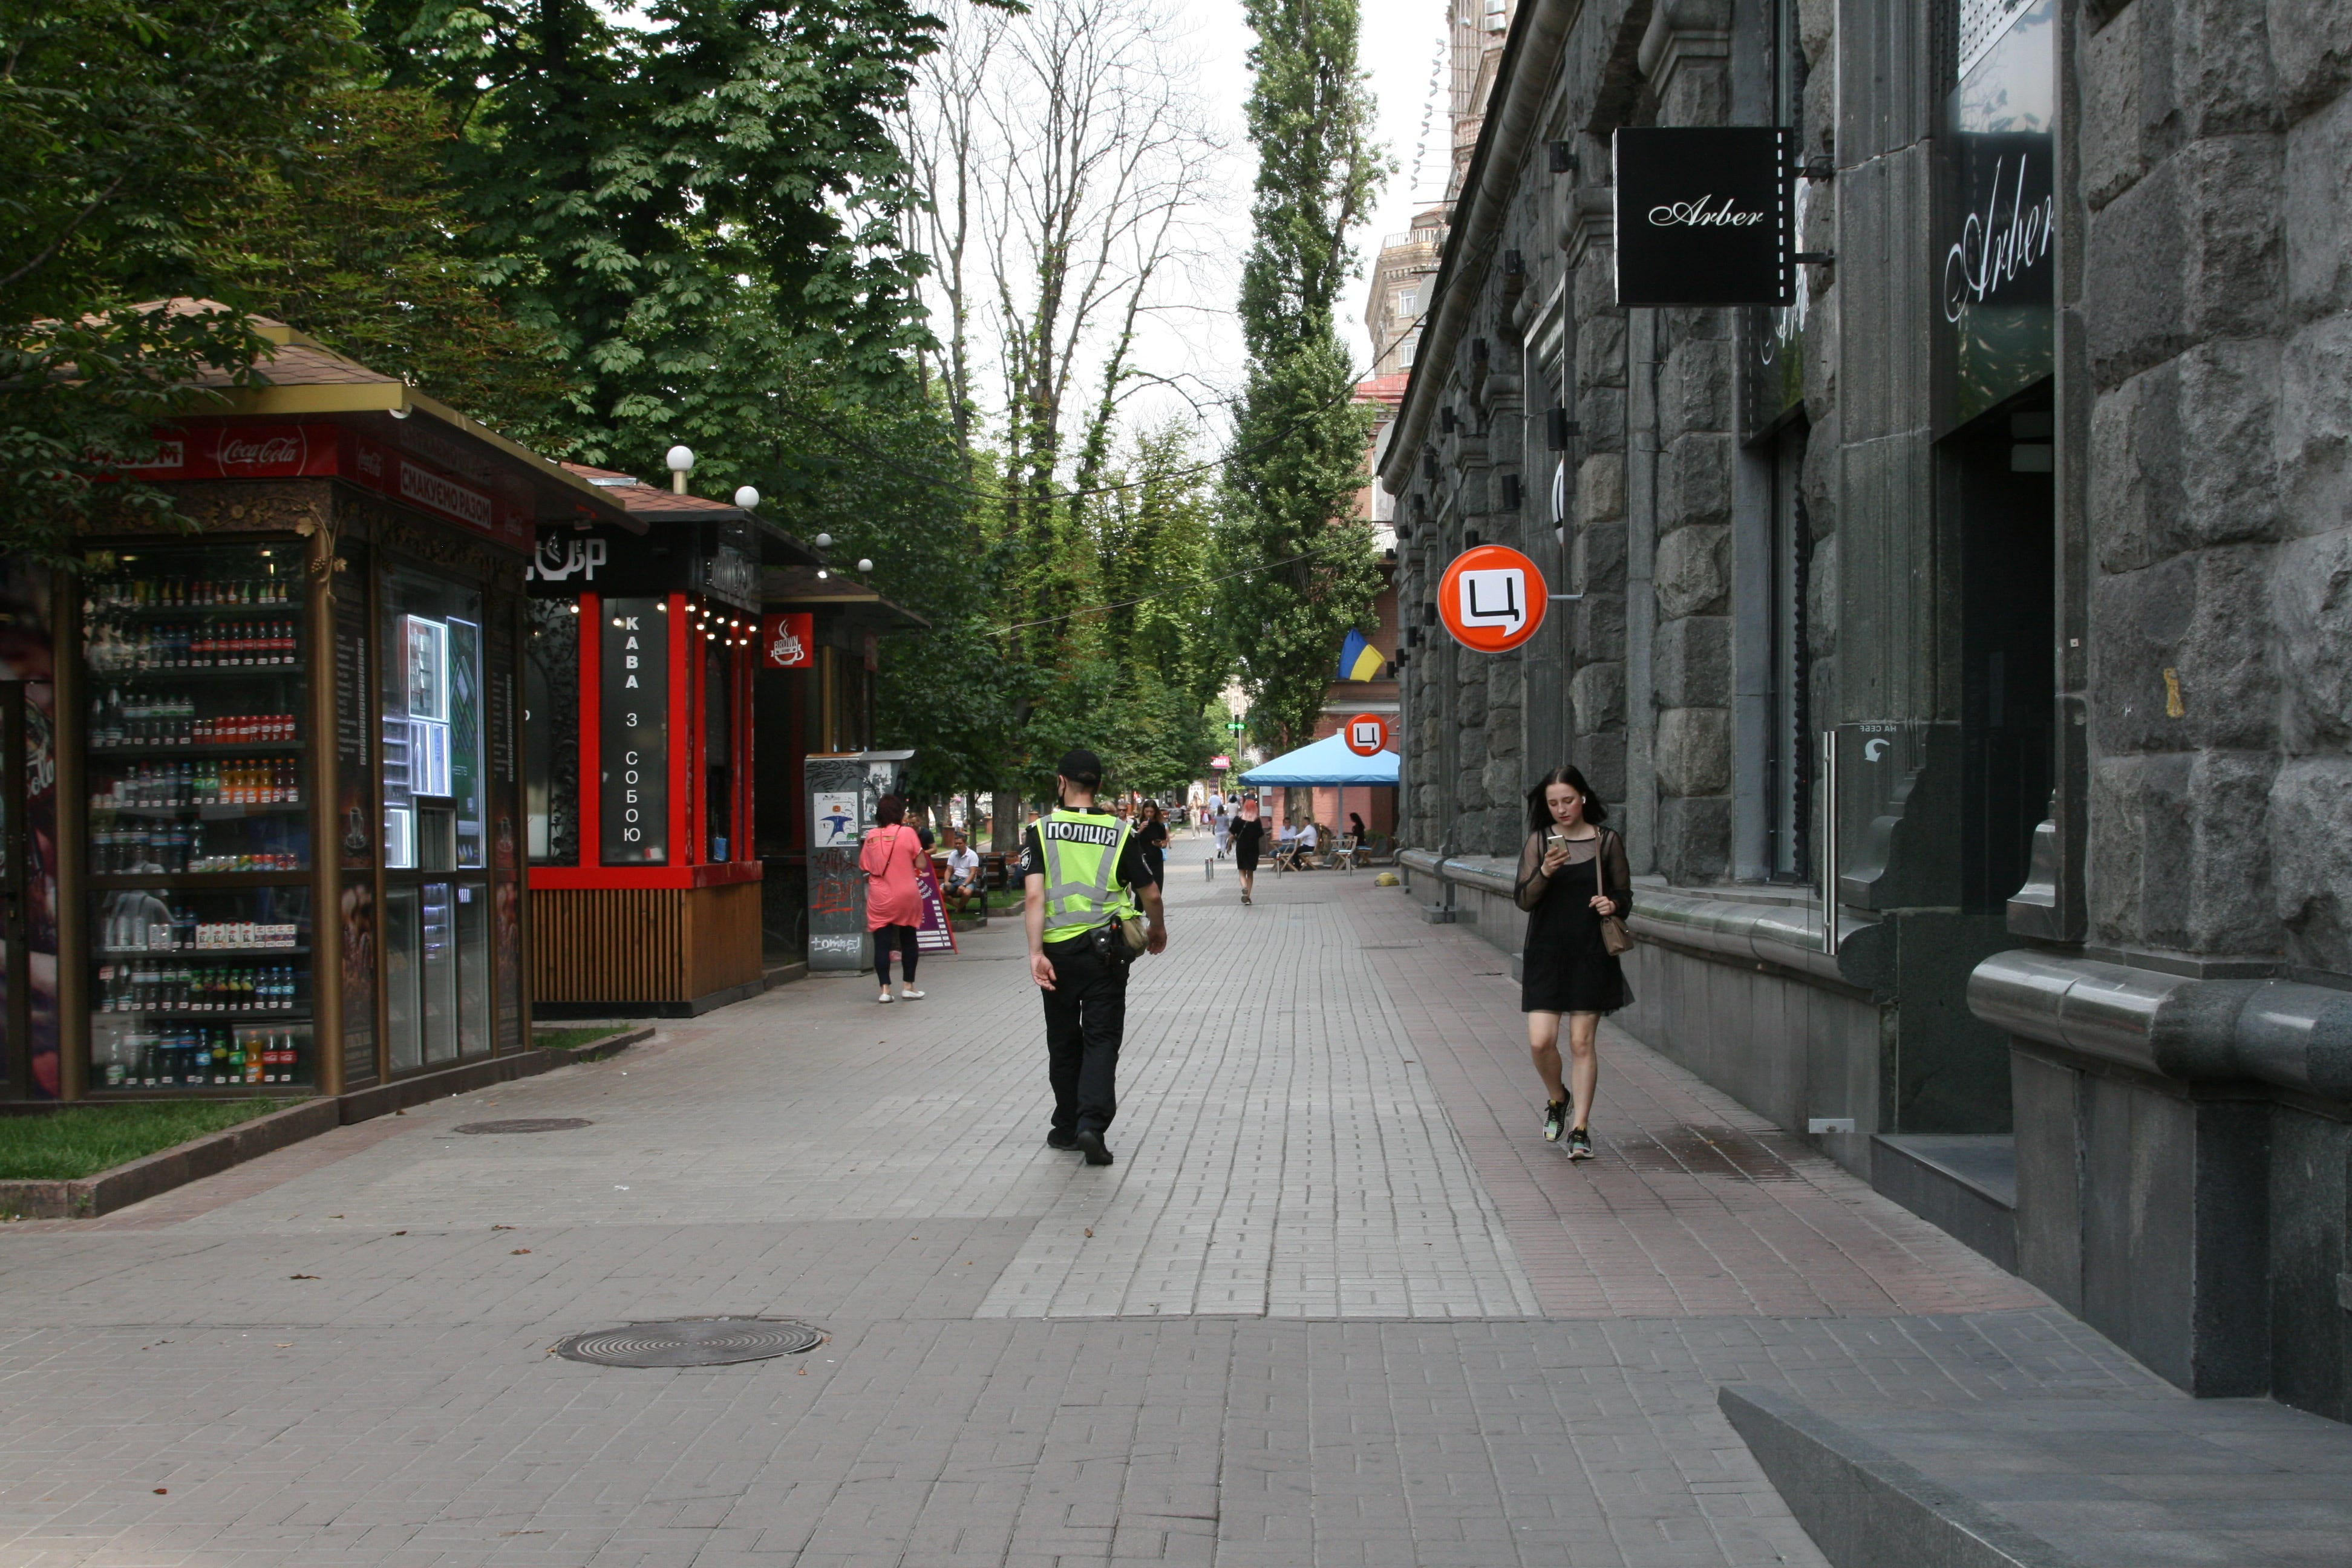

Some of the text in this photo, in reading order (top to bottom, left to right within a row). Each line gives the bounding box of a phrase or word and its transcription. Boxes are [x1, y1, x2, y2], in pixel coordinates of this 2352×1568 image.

[1648, 194, 1763, 226] Arber
[224, 437, 299, 464] Coca-Cola
[402, 466, 458, 512] СМАКУЄМО
[459, 492, 491, 526] РАЗОМ
[1469, 577, 1520, 621] Ц
[626, 616, 639, 688] КАВА
[774, 635, 798, 649] BROWN
[1356, 727, 1377, 746] Ц
[624, 751, 641, 842] СОБОЮ
[1048, 822, 1117, 846] ПОЛІЦІЯ
